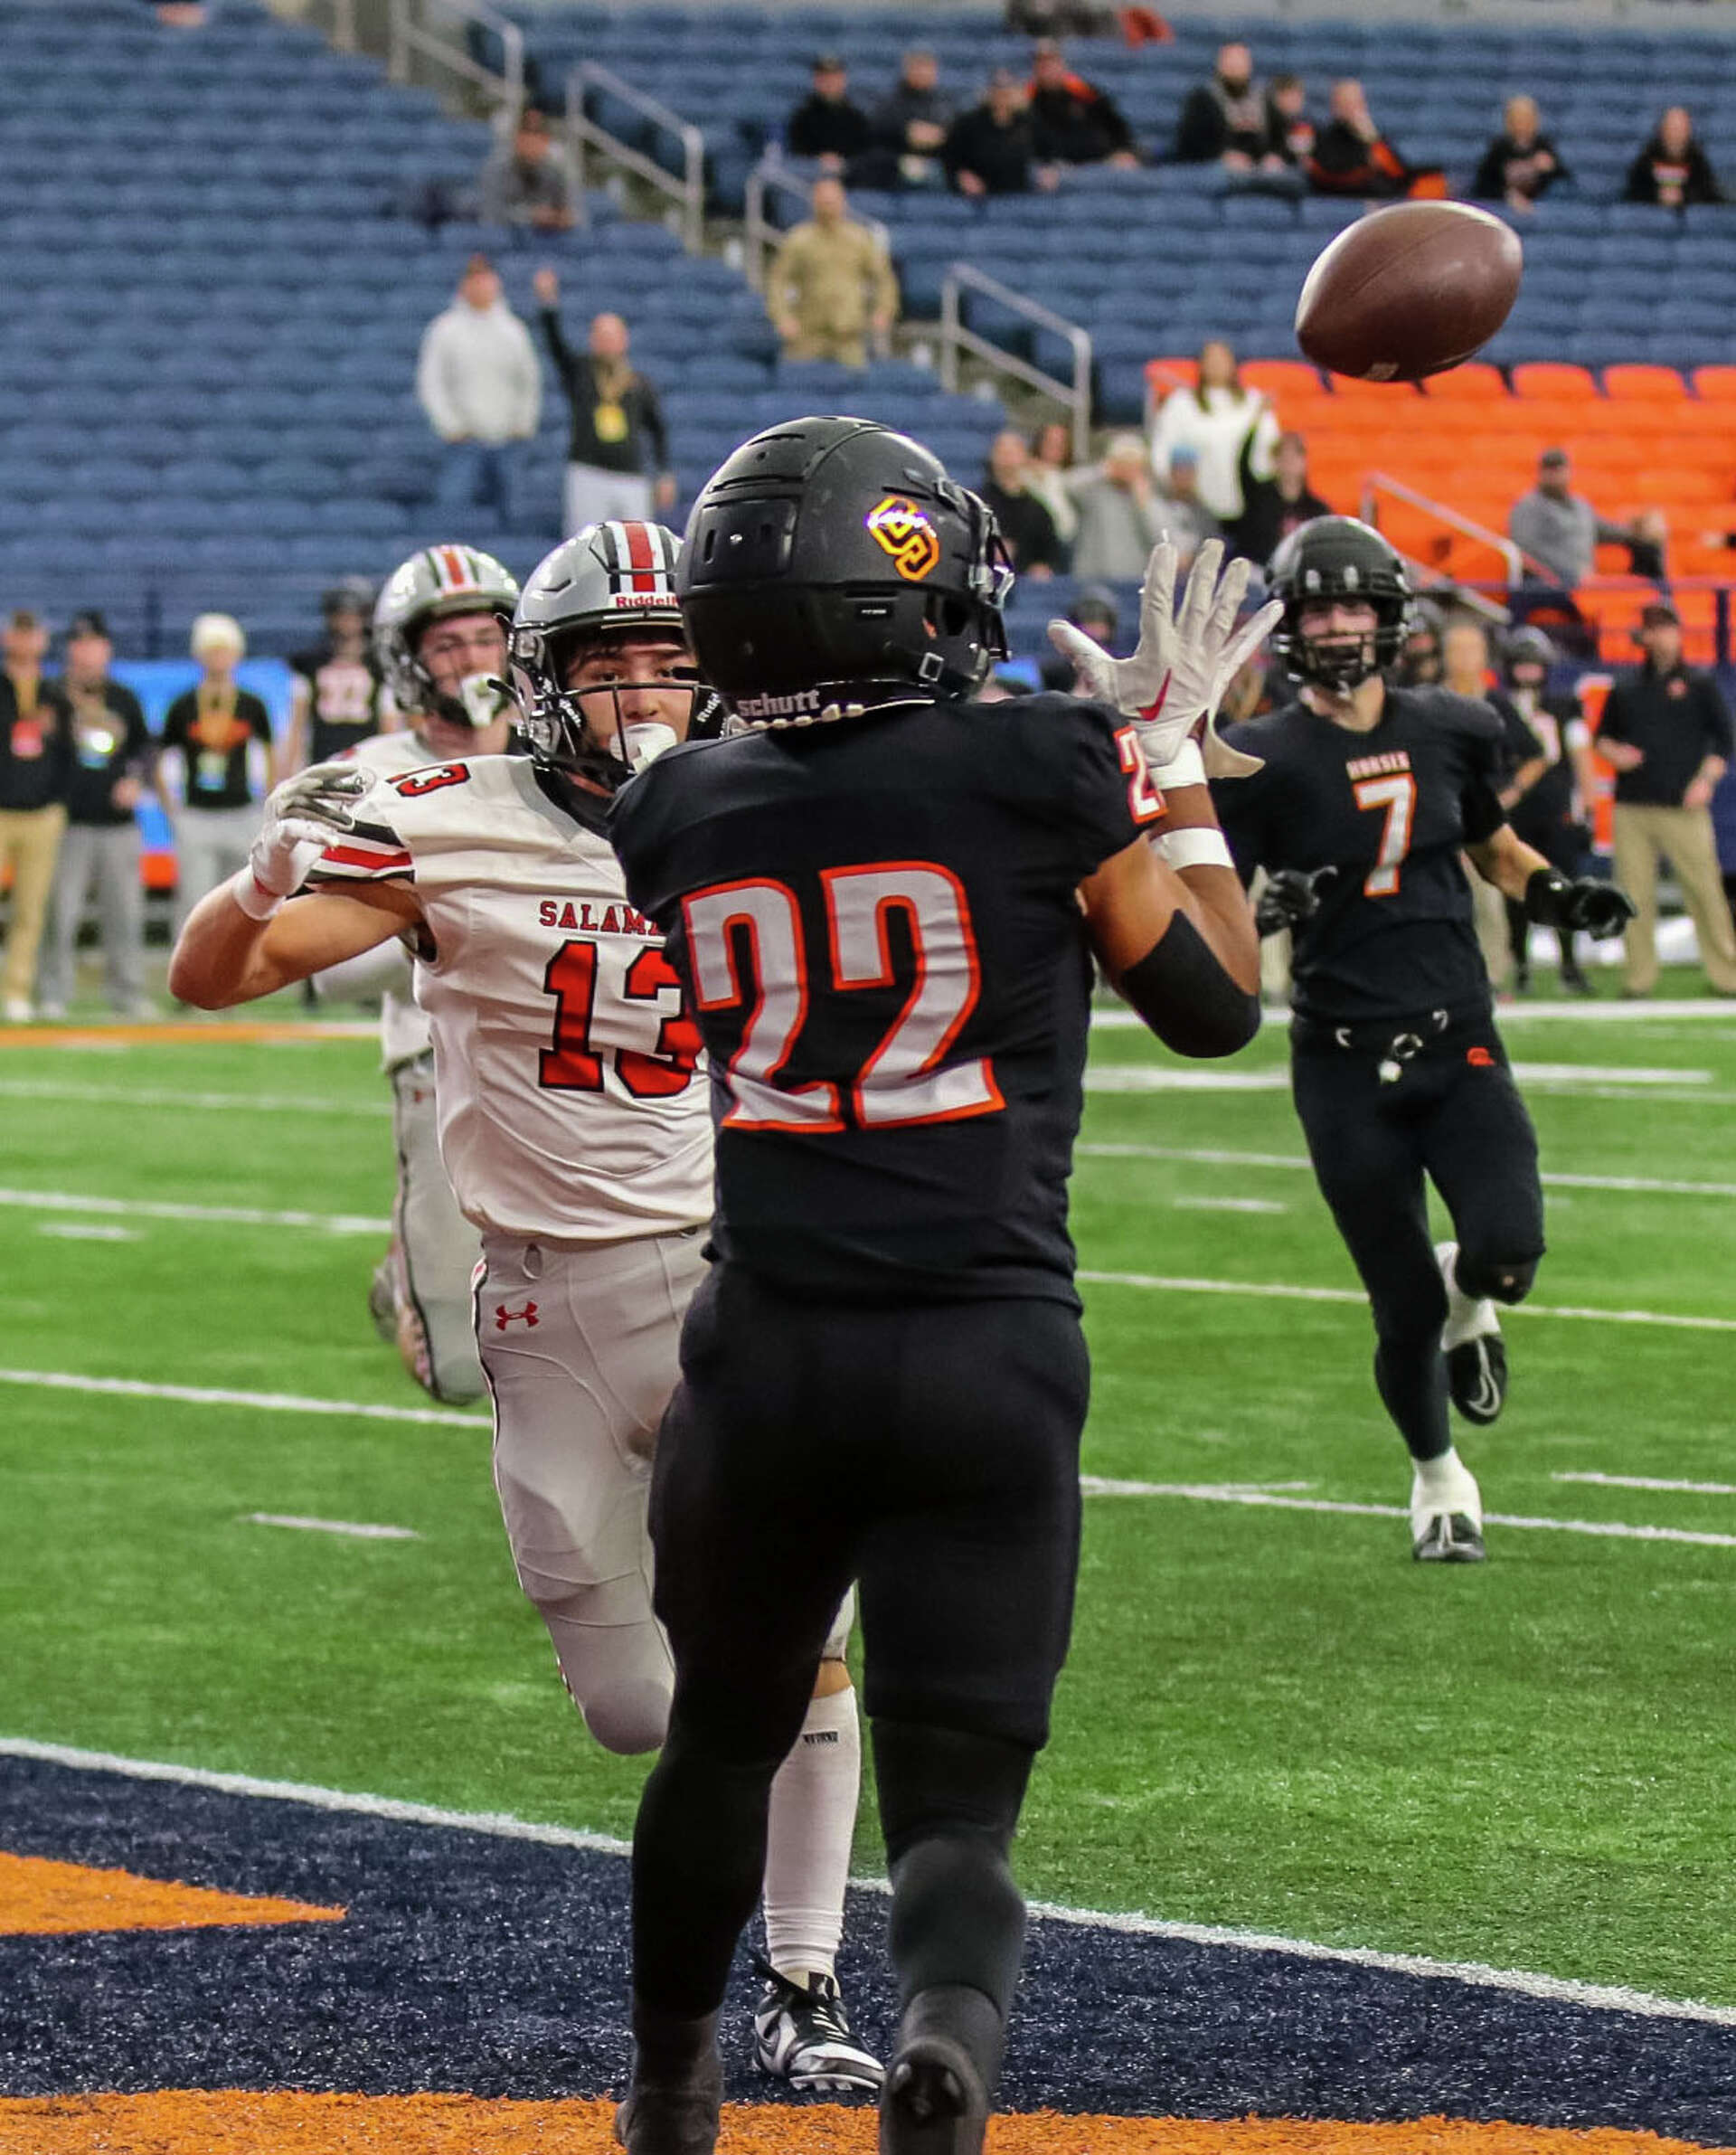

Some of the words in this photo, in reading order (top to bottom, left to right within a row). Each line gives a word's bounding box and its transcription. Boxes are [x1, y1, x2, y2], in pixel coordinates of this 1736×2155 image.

[616, 596, 678, 609] Riddell
[737, 689, 820, 717] schutt
[1353, 772, 1418, 897] 7
[539, 939, 704, 1099] 13
[682, 860, 1006, 1133] 22
